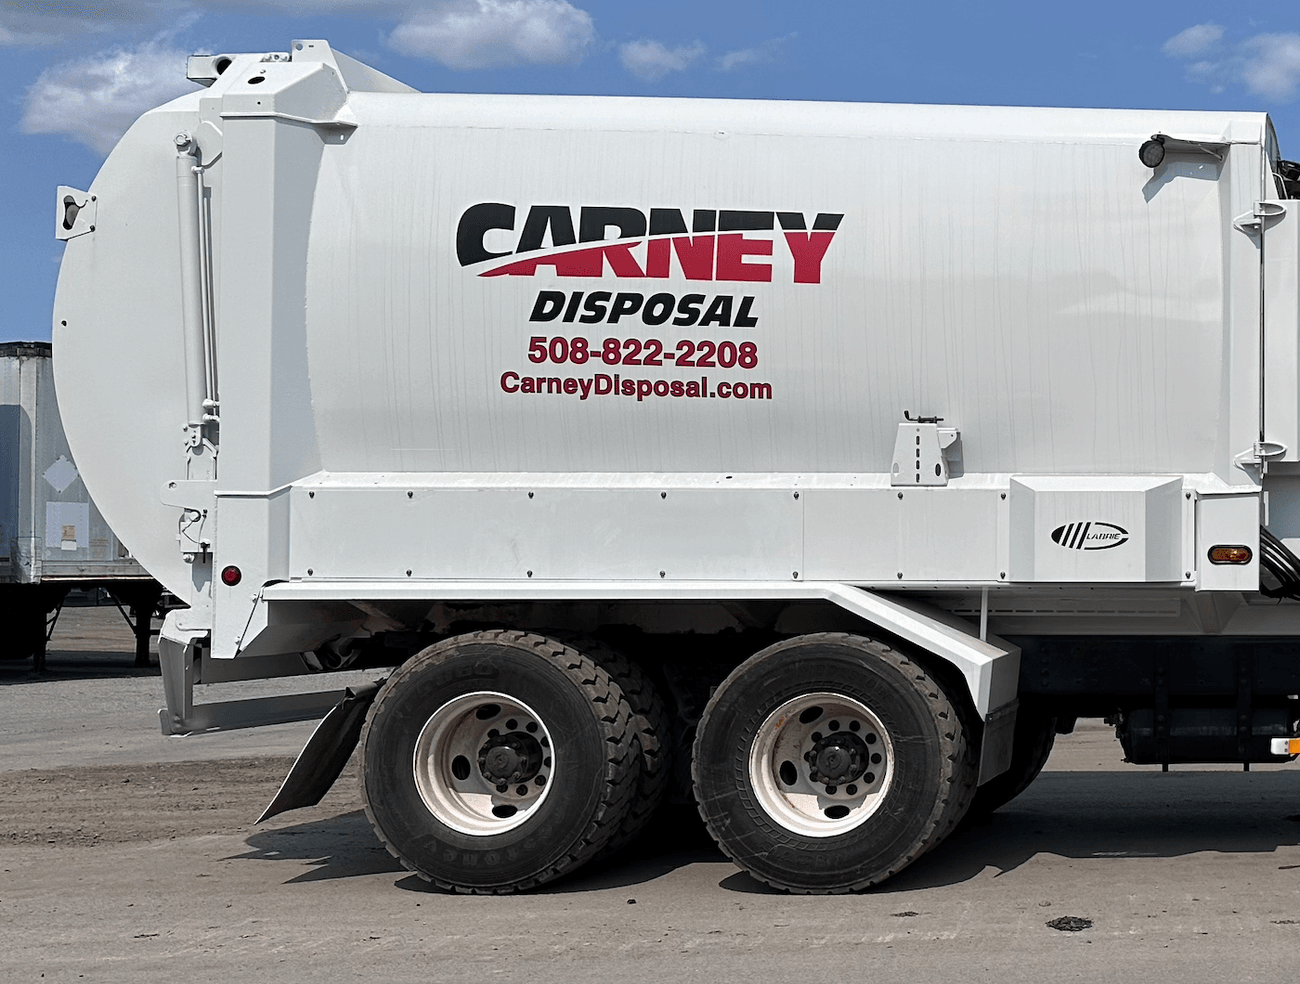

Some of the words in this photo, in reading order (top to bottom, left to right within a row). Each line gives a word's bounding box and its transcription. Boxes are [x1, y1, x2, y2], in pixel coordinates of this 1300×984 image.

[456, 203, 845, 284] CARNEY
[528, 290, 759, 328] DISPOSAL
[528, 336, 759, 369] 508-822-2208
[500, 372, 773, 401] CarneyDisposal.com
